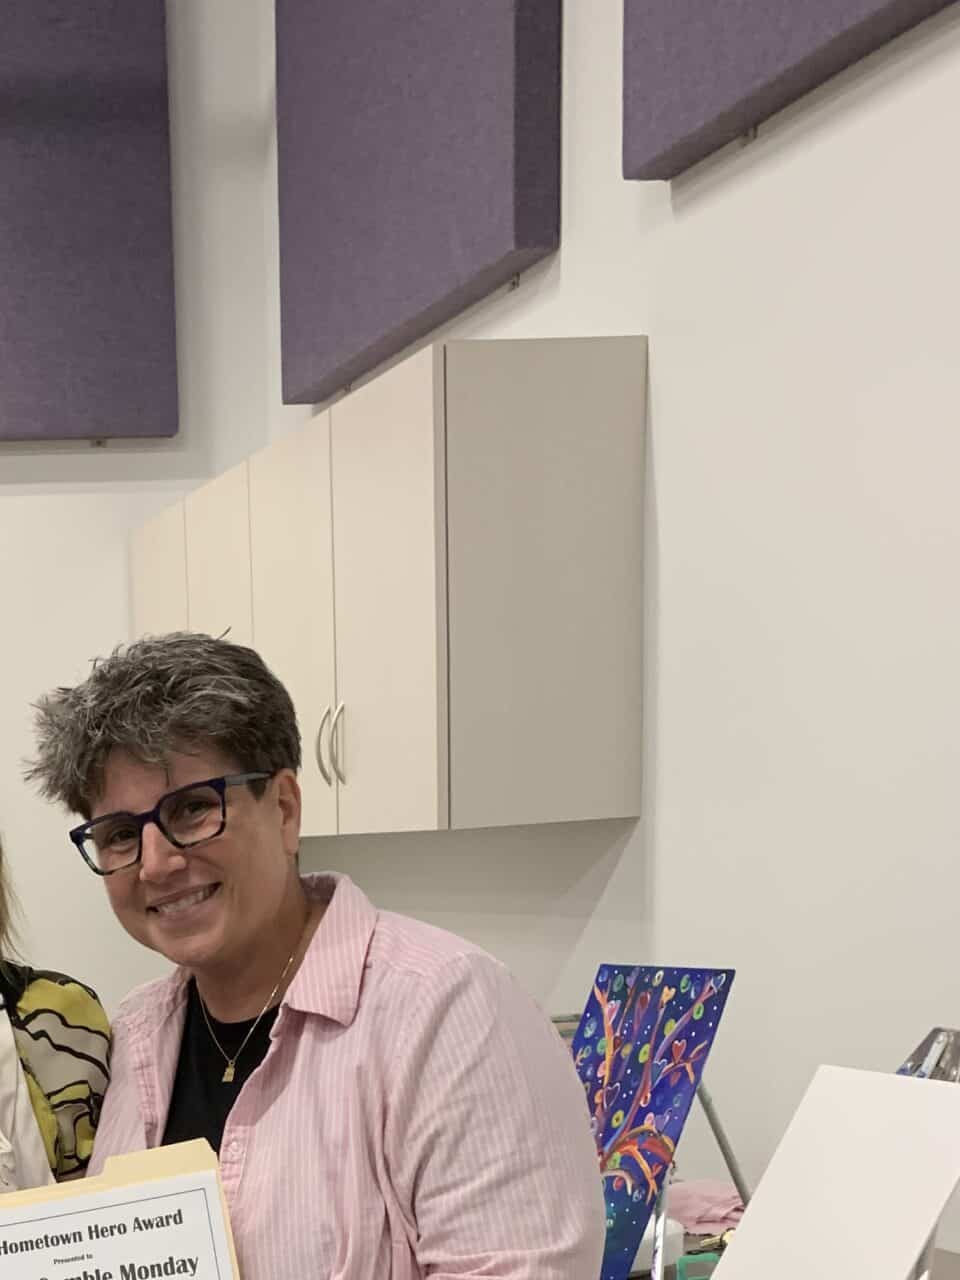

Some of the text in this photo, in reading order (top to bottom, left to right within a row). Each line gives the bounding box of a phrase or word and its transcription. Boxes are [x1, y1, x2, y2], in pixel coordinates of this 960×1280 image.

[87, 1221, 127, 1240] Hero
[132, 1209, 184, 1233] Award
[54, 1255, 85, 1265] Presented
